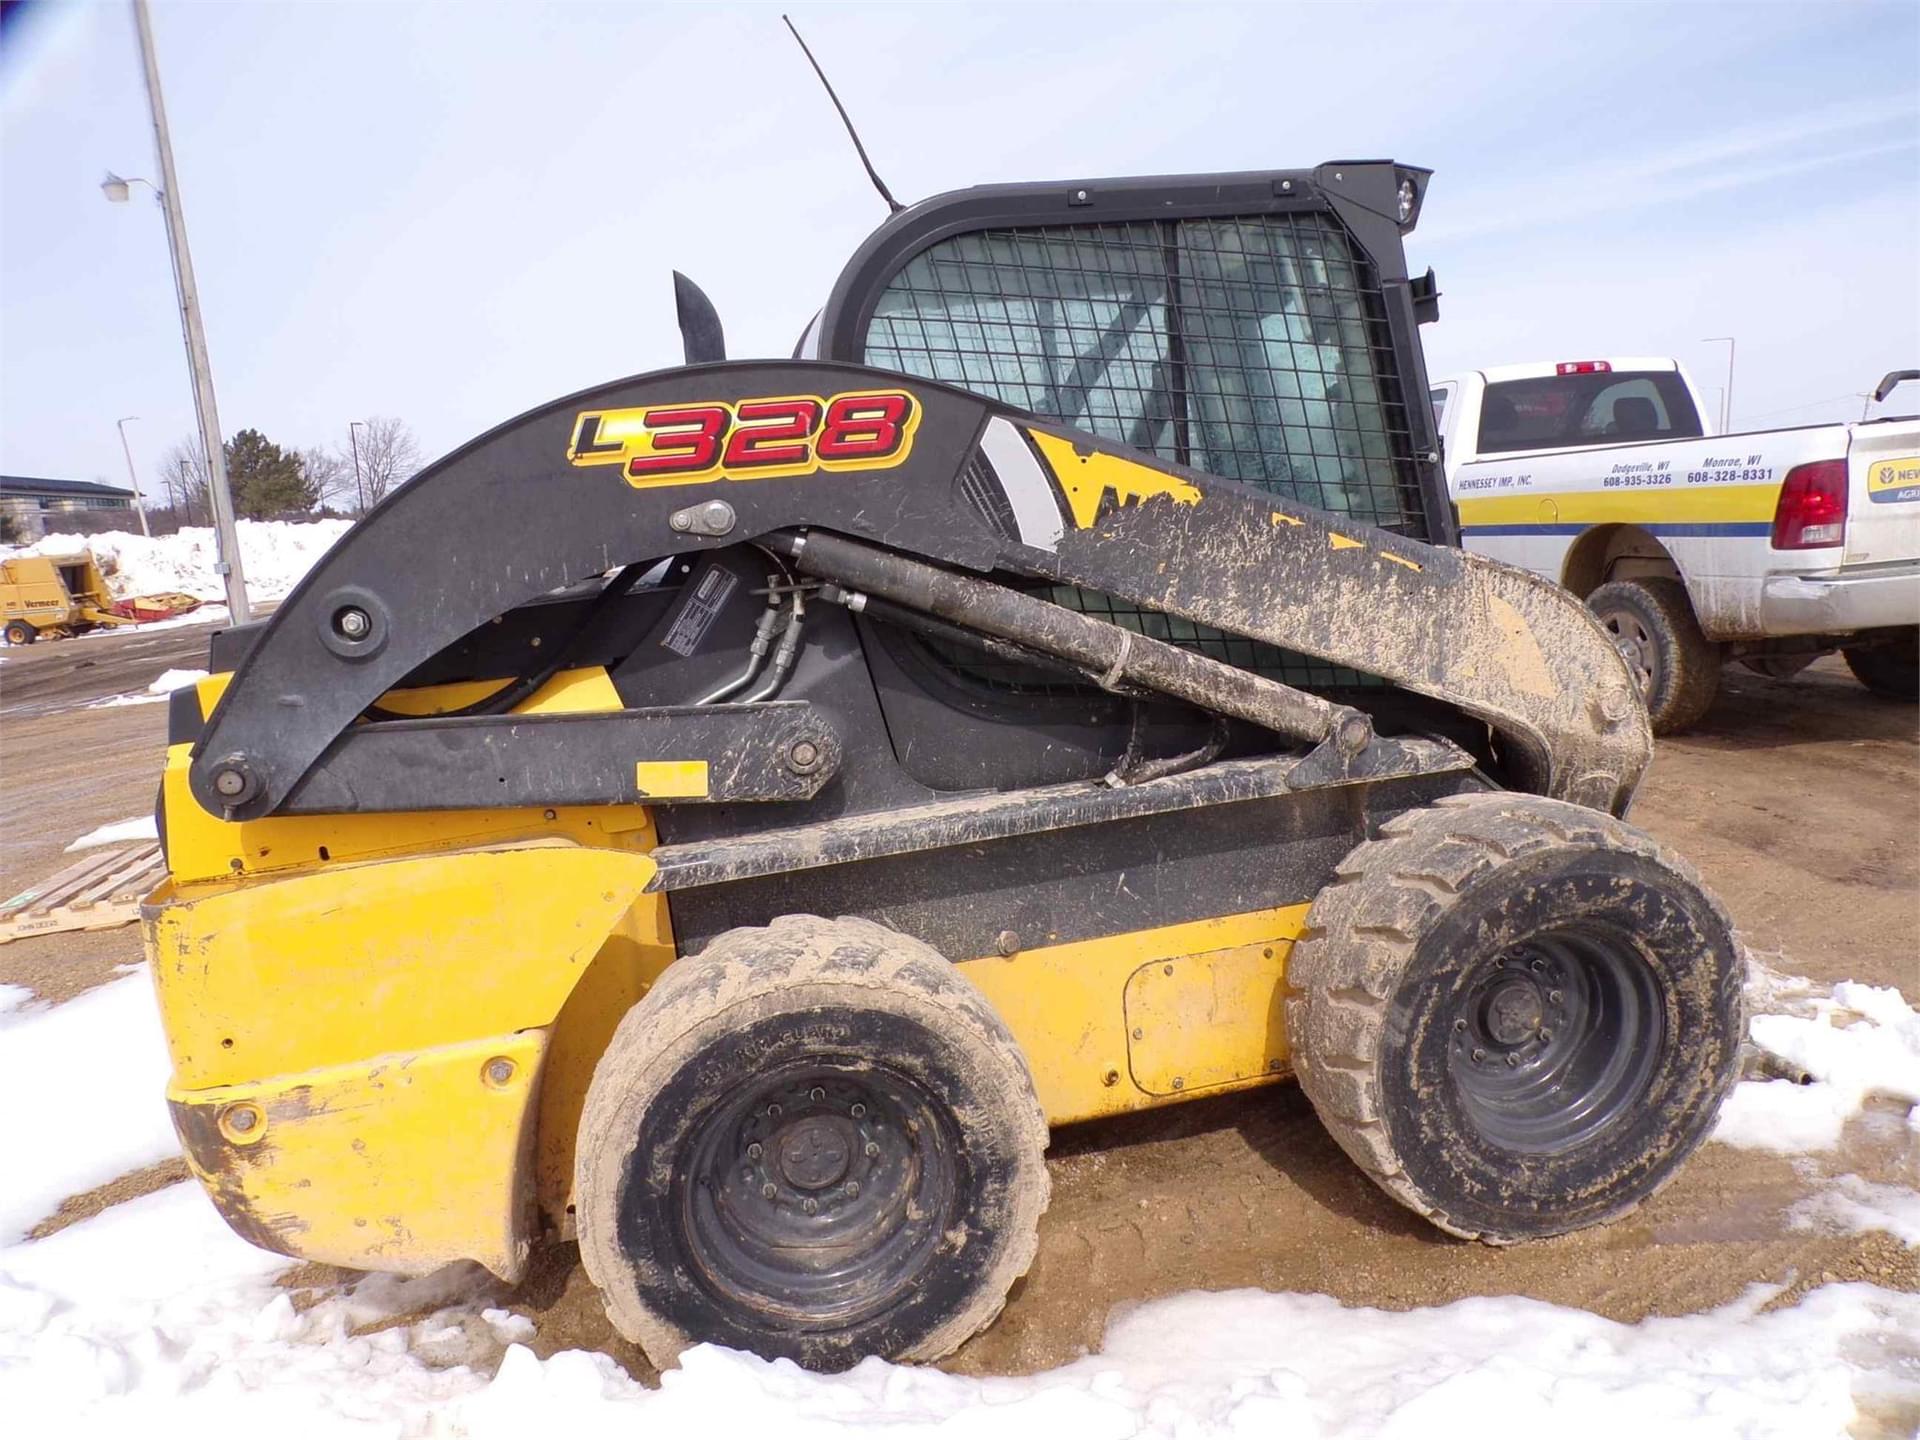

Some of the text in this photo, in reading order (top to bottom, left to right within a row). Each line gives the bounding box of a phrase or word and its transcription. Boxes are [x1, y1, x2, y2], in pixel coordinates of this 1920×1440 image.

[1611, 460, 1671, 474] Dodgeville, WI
[1702, 454, 1762, 469] Monroe, WI
[1458, 477, 1497, 490] HENNESSEY
[1517, 474, 1533, 486] INC.
[1603, 473, 1673, 487] 608-935-3326
[1687, 468, 1774, 483] 608-328-8331
[24, 600, 59, 608] Vermeer
